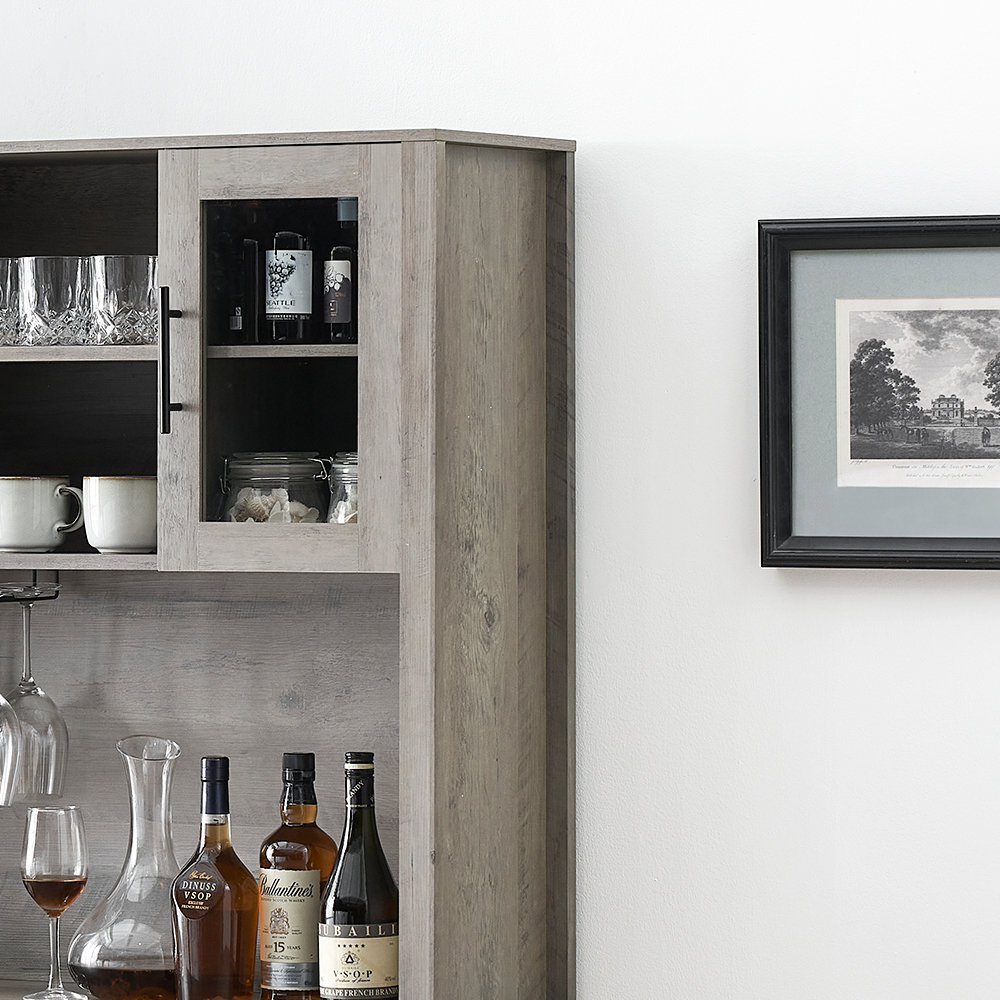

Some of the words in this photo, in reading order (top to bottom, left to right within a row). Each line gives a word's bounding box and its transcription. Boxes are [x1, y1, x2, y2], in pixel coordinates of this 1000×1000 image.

[182, 880, 217, 891] DINUSS
[260, 873, 314, 897] Ballantine's
[184, 891, 212, 900] VSOP
[273, 941, 285, 953] 15
[344, 988, 374, 997] FRENCH
